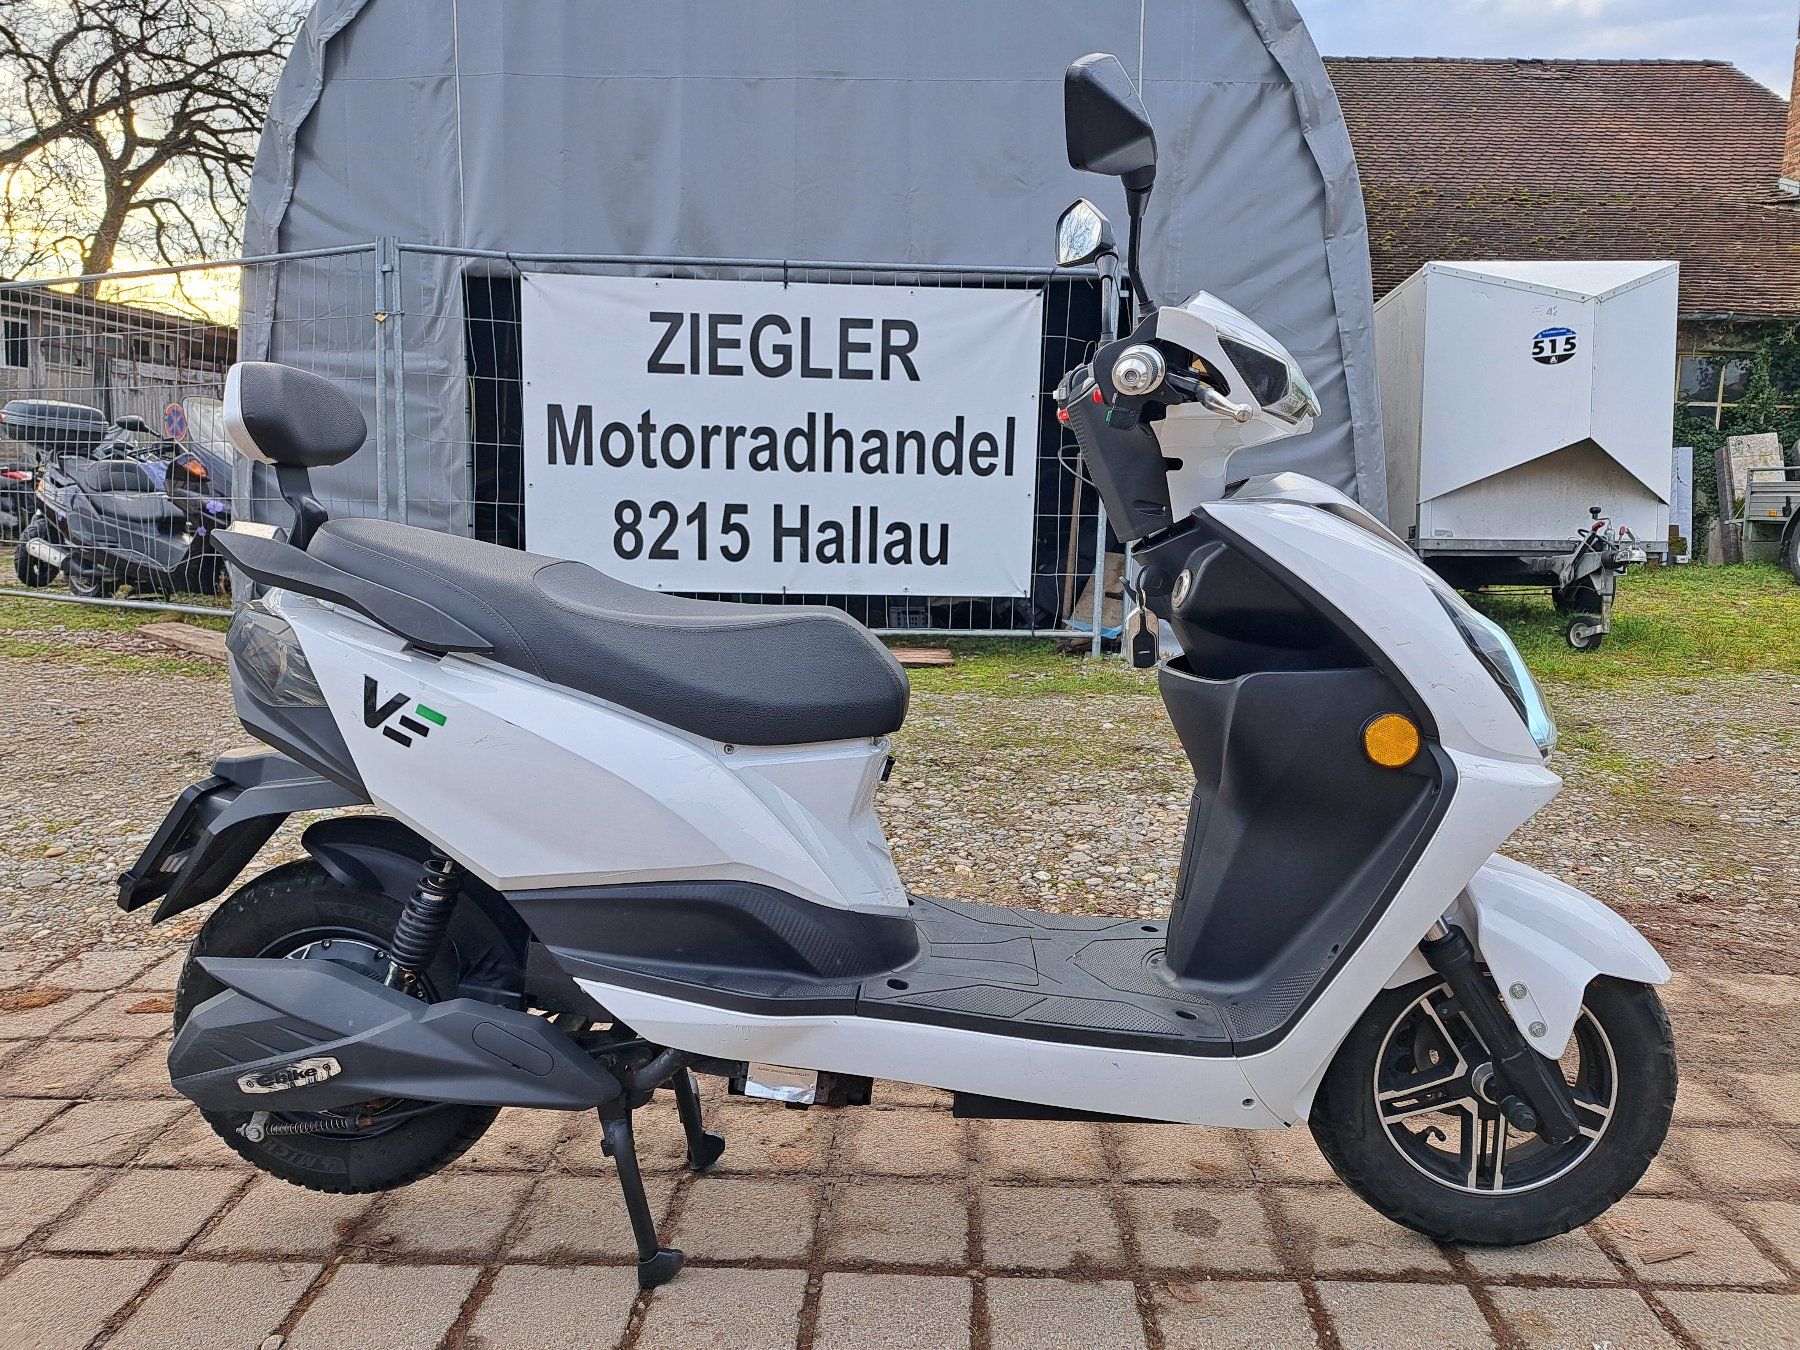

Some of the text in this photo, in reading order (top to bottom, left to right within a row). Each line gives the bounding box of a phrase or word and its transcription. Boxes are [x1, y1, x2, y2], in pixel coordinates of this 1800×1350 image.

[647, 311, 921, 382] ZIEGLER
[1531, 335, 1577, 356] 515
[546, 403, 1016, 477] Motorradhandel
[613, 499, 949, 566] 8215 Hallau
